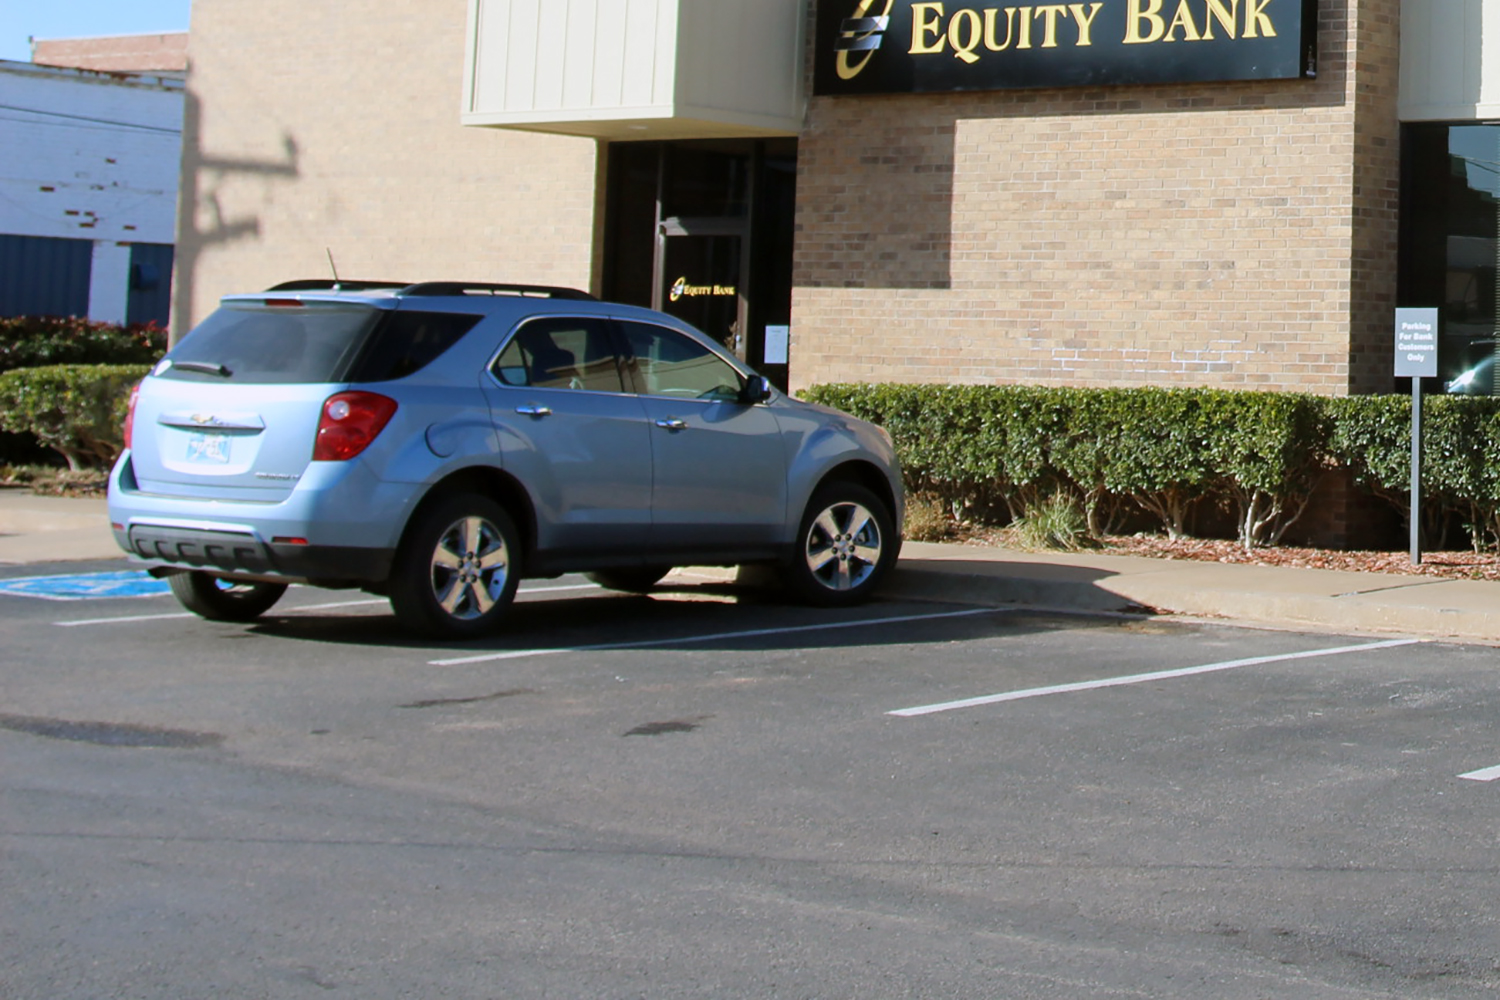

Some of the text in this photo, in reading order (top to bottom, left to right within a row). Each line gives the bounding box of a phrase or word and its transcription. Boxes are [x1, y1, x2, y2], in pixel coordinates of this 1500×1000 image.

[908, 1, 1104, 64] EQUITY
[683, 284, 735, 297] EQUITY BANK
[1401, 322, 1431, 332] Parking
[1399, 332, 1433, 341] For Bank
[1398, 343, 1434, 351] Customers
[1407, 353, 1425, 362] Only
